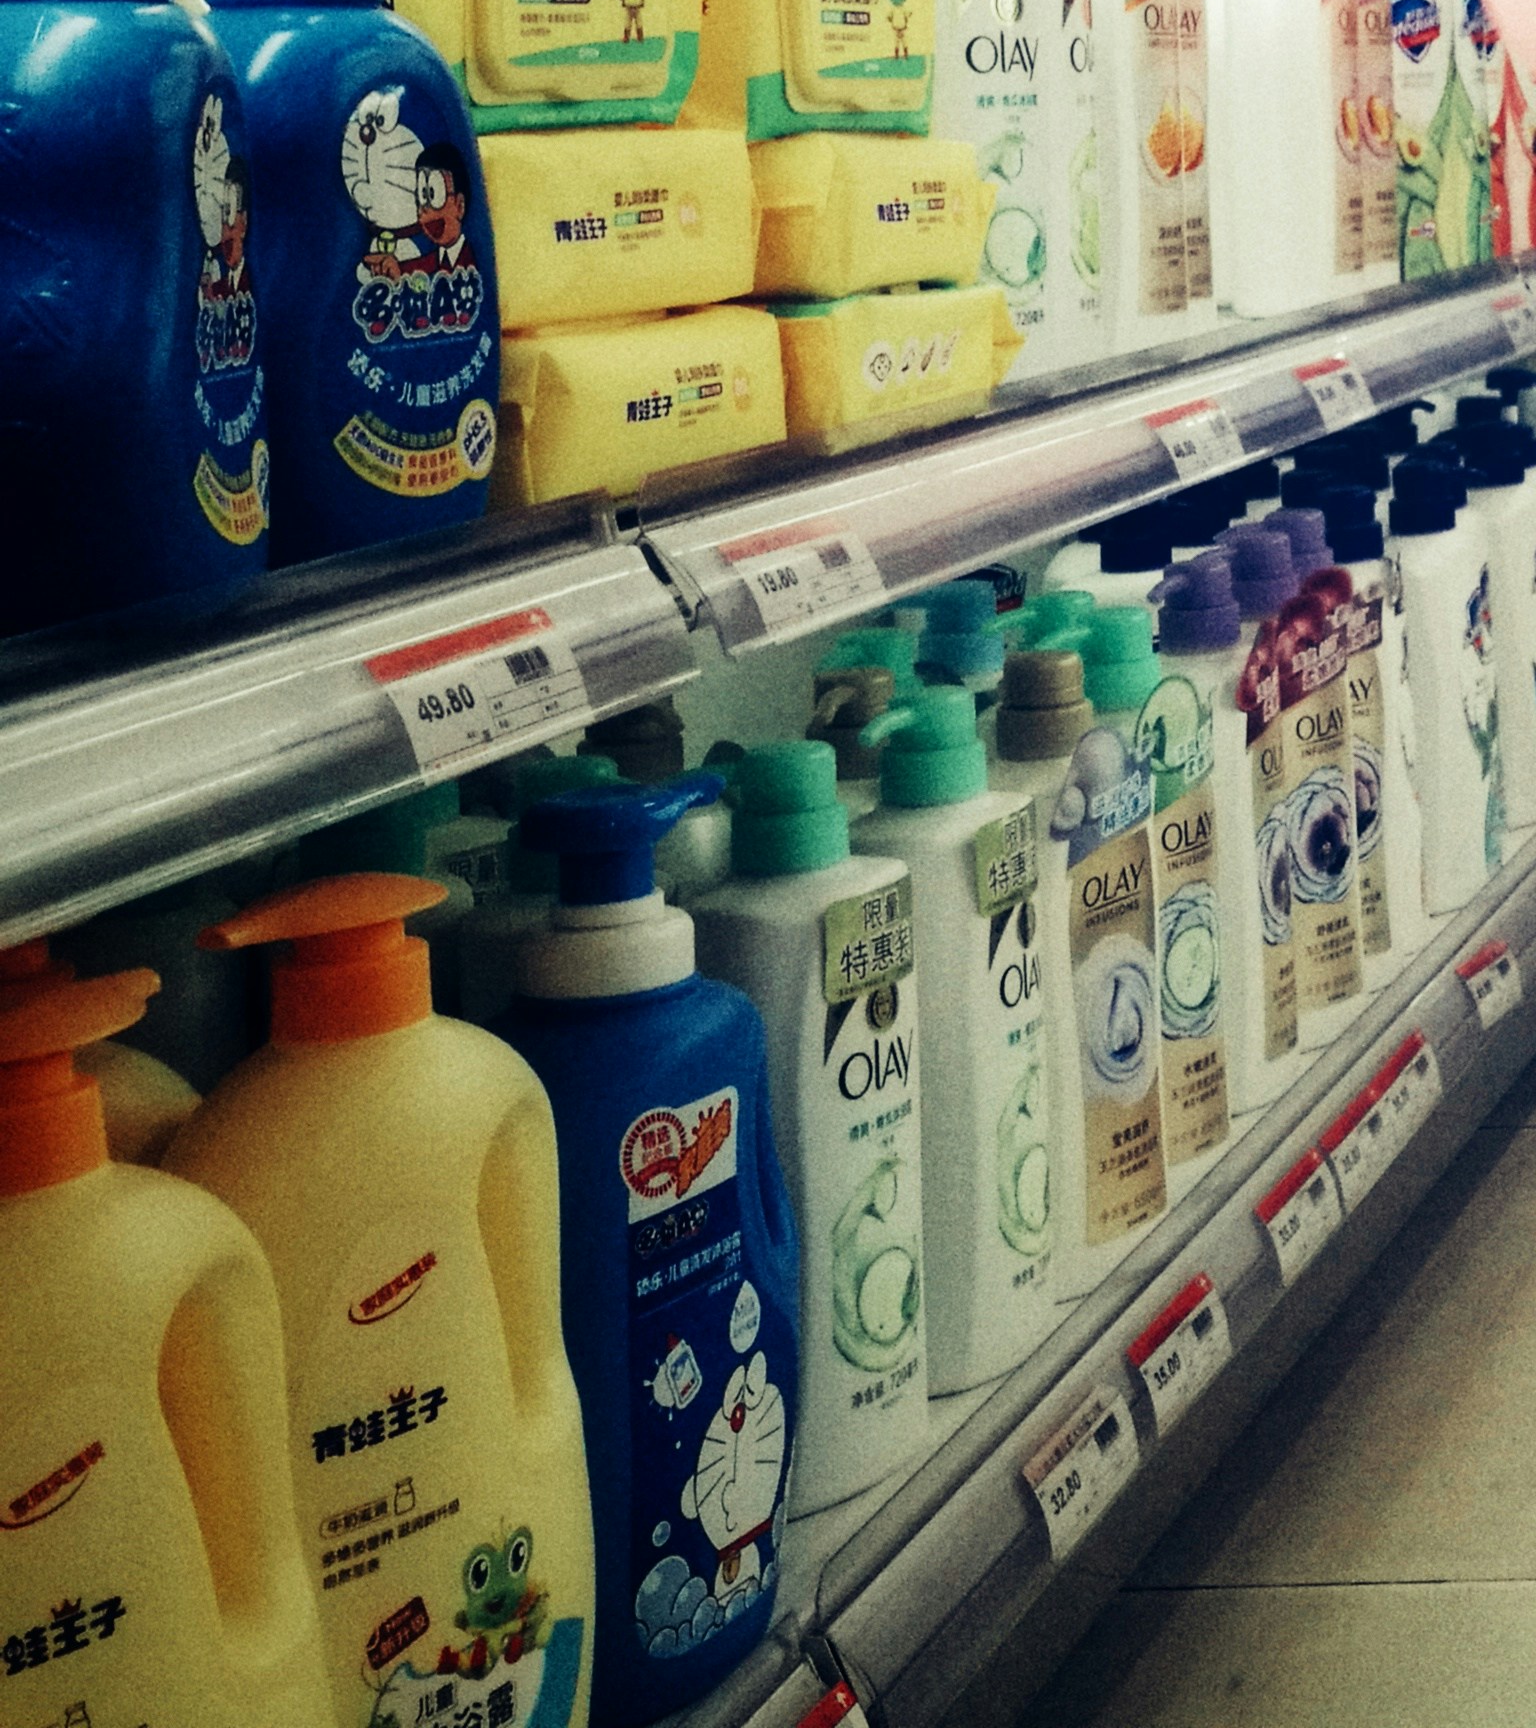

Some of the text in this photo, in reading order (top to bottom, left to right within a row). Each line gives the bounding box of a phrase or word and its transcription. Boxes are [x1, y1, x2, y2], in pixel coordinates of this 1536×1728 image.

[965, 30, 1040, 82] OLAY
[554, 216, 608, 243] 青蛙王子
[627, 394, 673, 423] 青蛙王子
[757, 565, 799, 595] 19.80
[417, 682, 476, 723] 49.80
[1083, 859, 1148, 909] OLAY
[862, 888, 899, 931] 限量
[838, 1028, 915, 1101] OLAY
[312, 1385, 449, 1464] 青蛙王子
[1049, 1468, 1083, 1516] 32.80
